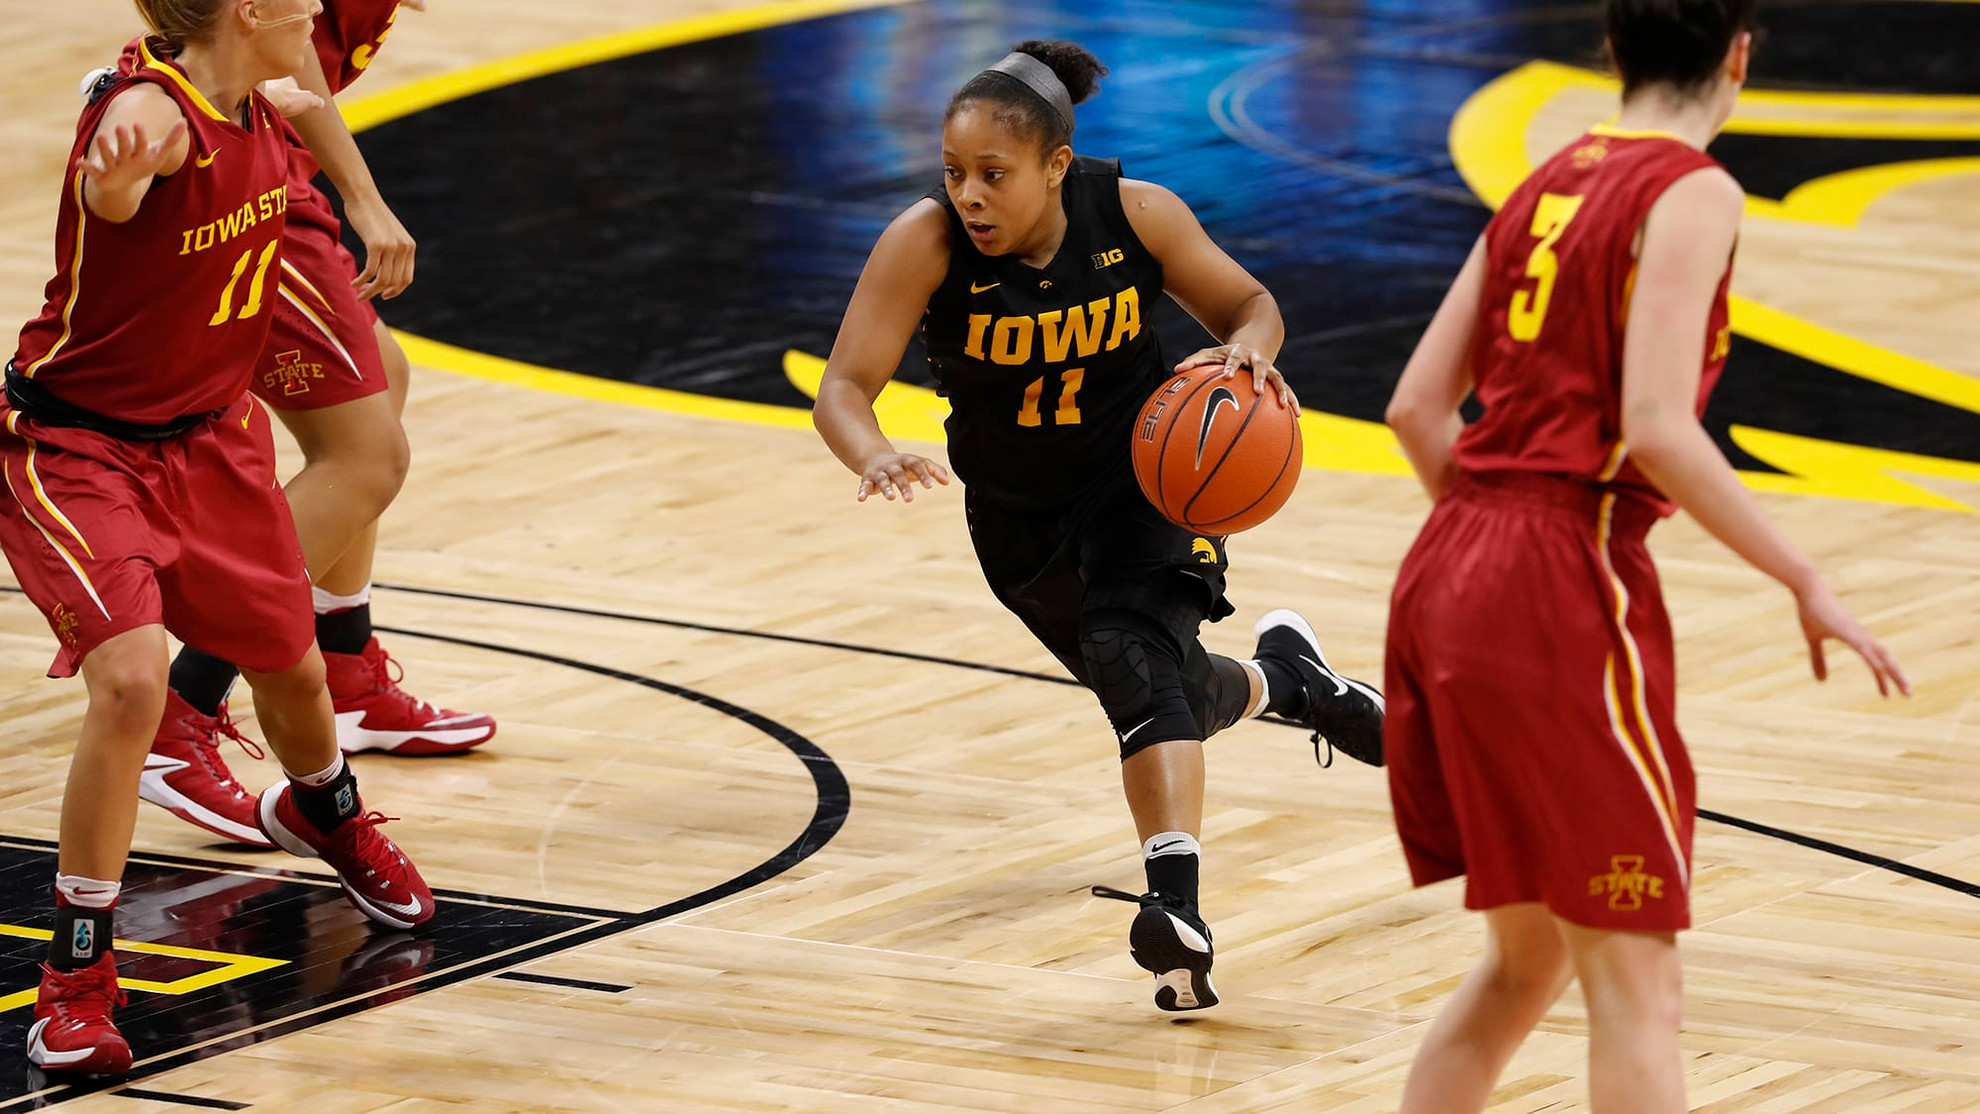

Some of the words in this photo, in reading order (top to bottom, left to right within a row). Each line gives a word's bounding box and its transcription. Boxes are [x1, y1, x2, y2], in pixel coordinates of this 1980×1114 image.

[178, 201, 256, 255] IOWA
[208, 238, 278, 326] 11
[1508, 193, 1584, 342] 3
[964, 286, 1142, 365] IOWA
[263, 363, 325, 389] STATE
[1017, 367, 1085, 427] 11
[1588, 873, 1664, 899] STATE
